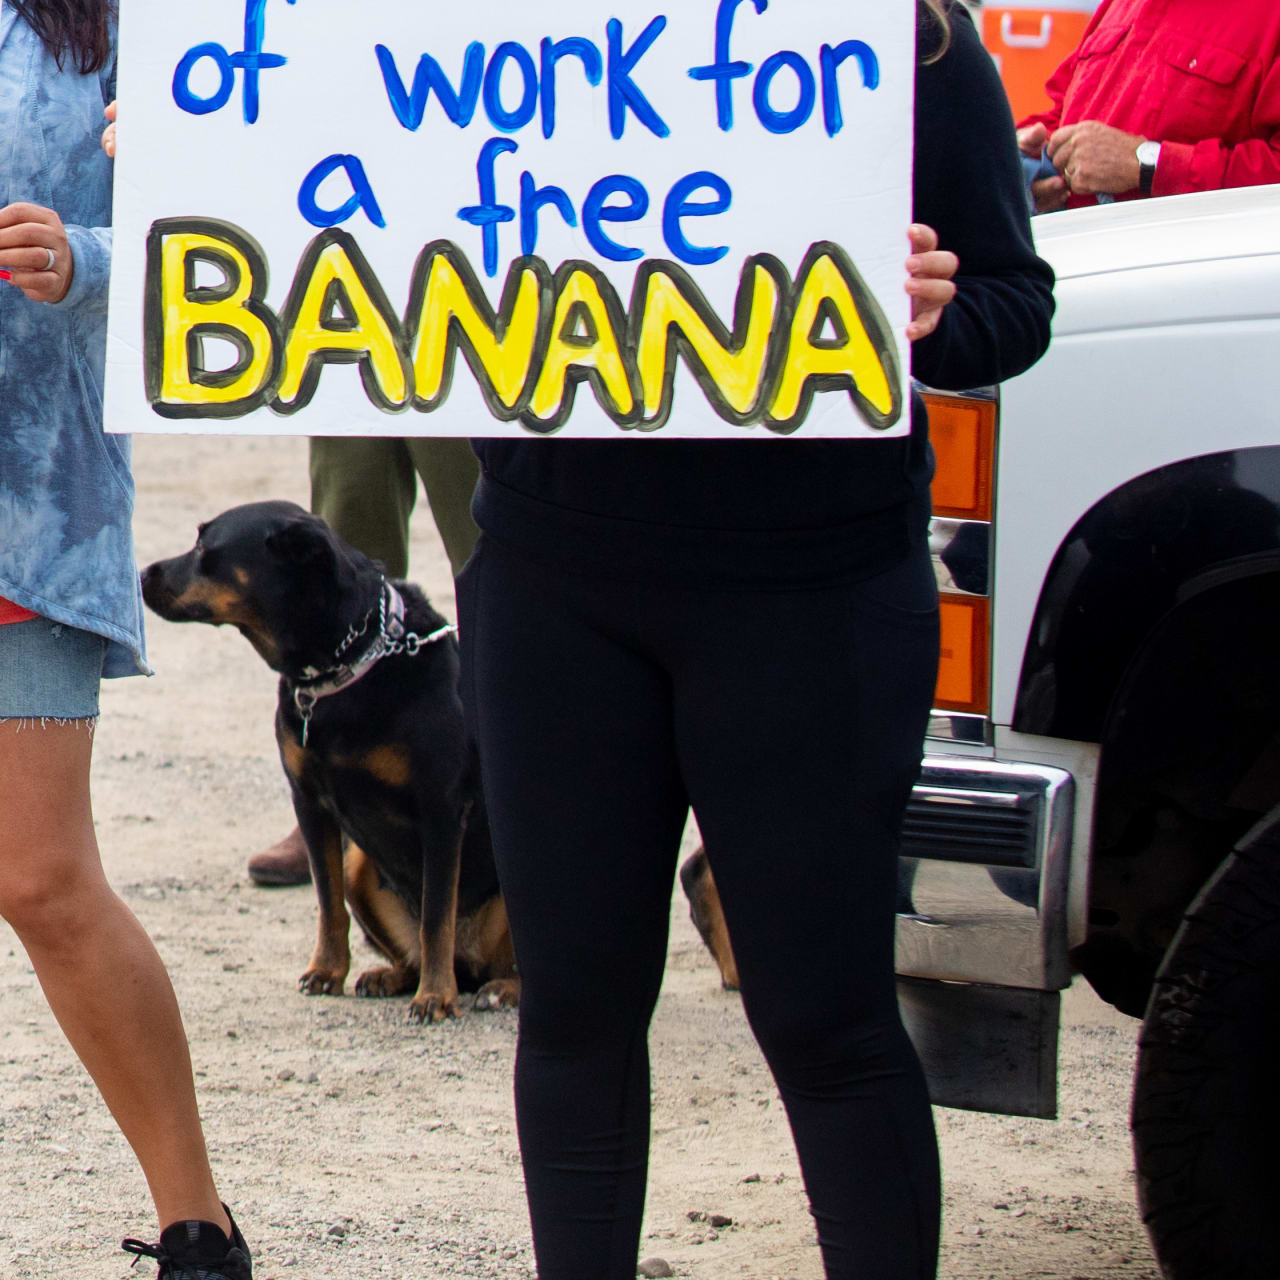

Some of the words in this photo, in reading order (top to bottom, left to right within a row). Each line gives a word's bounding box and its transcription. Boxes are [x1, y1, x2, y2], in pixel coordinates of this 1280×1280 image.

[374, 14, 671, 141] work
[296, 153, 387, 229] a
[456, 136, 733, 279] free
[144, 216, 902, 435] BANANA
